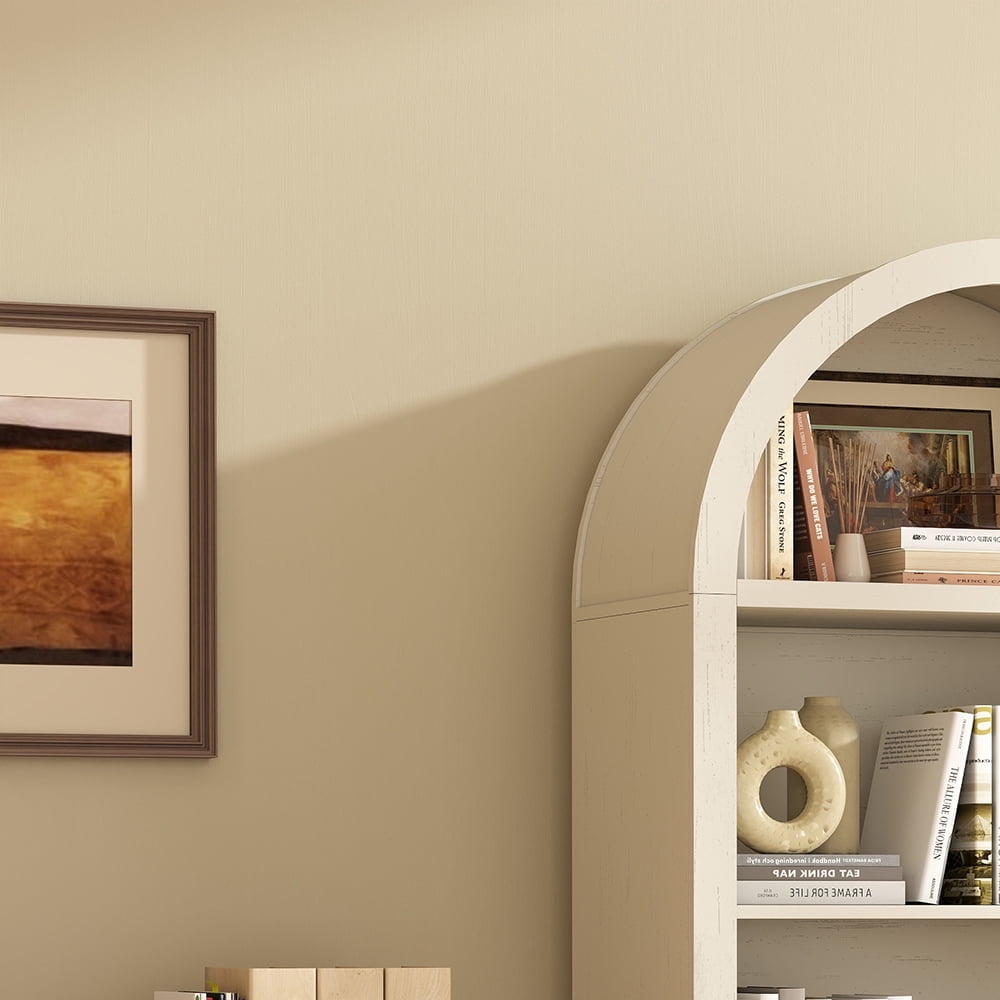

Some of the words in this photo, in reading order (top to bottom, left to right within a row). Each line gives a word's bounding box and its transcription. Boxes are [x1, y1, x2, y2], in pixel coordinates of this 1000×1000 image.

[778, 447, 786, 460] the
[778, 462, 788, 495] WOLF
[805, 468, 813, 484] WHY
[808, 484, 814, 494] DO
[809, 495, 816, 505] WE
[778, 501, 786, 525] GREG
[810, 506, 819, 523] LOVE
[778, 527, 787, 553] STONE
[814, 523, 823, 540] CATS
[947, 767, 960, 784] THE
[941, 783, 956, 816] ALLURE
[938, 816, 949, 828] OF
[932, 828, 947, 861] WOMEN
